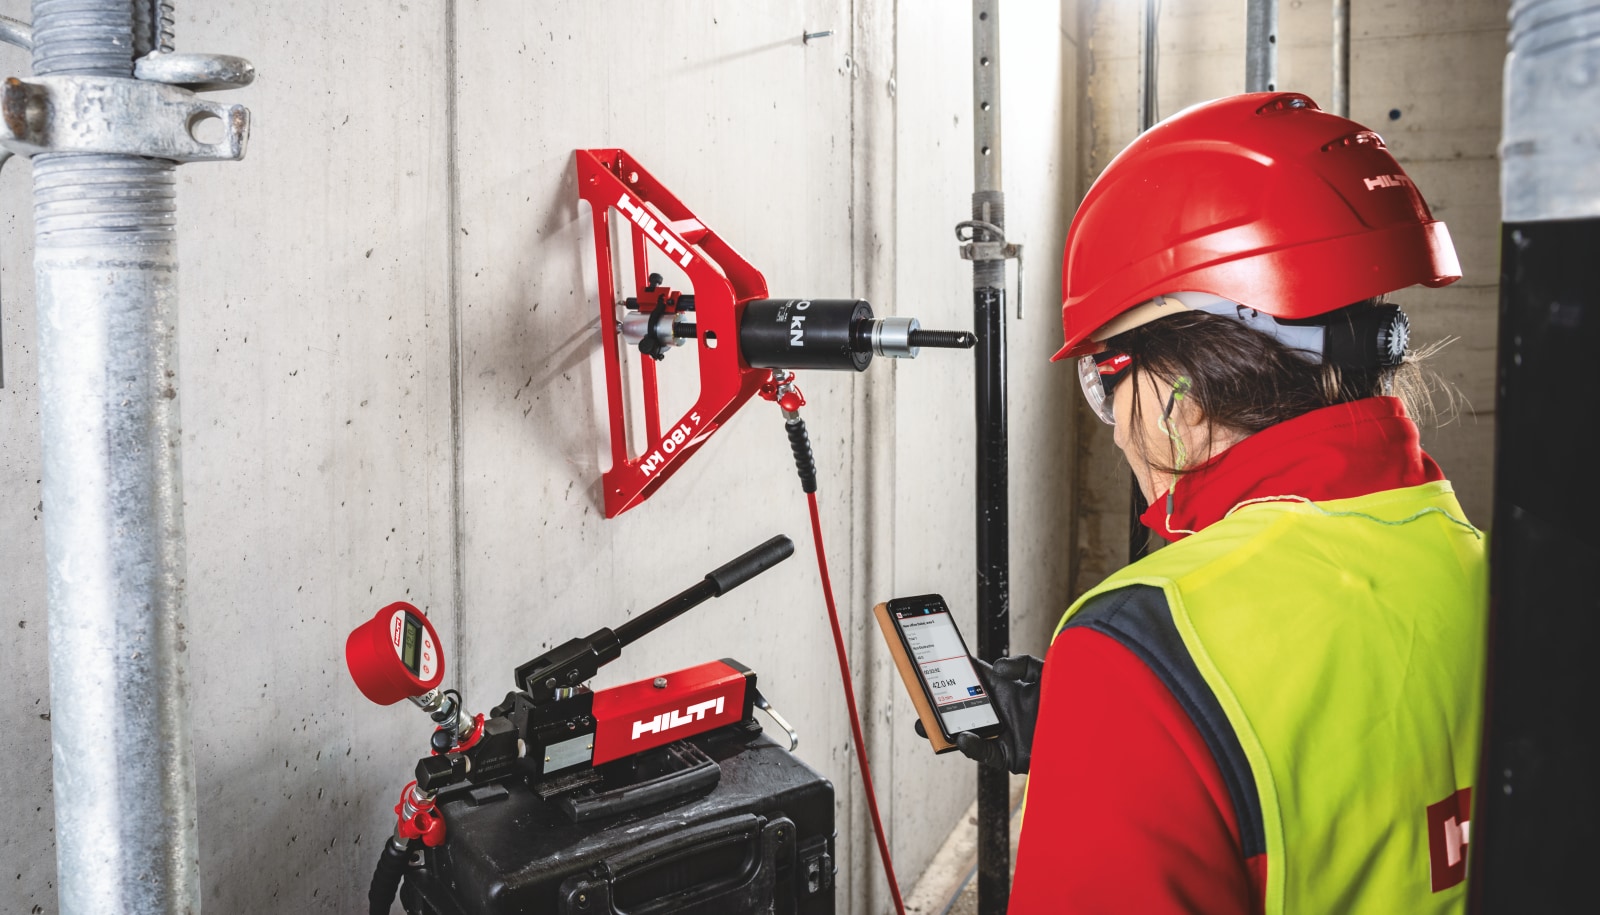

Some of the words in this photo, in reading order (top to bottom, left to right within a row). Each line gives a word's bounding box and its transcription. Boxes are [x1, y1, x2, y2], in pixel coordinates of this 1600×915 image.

[616, 192, 694, 268] HILTI
[662, 423, 692, 454] 180
[640, 450, 665, 477] kN
[932, 680, 946, 689] 42.0
[946, 678, 956, 687] kN
[631, 696, 725, 740] HILTI
